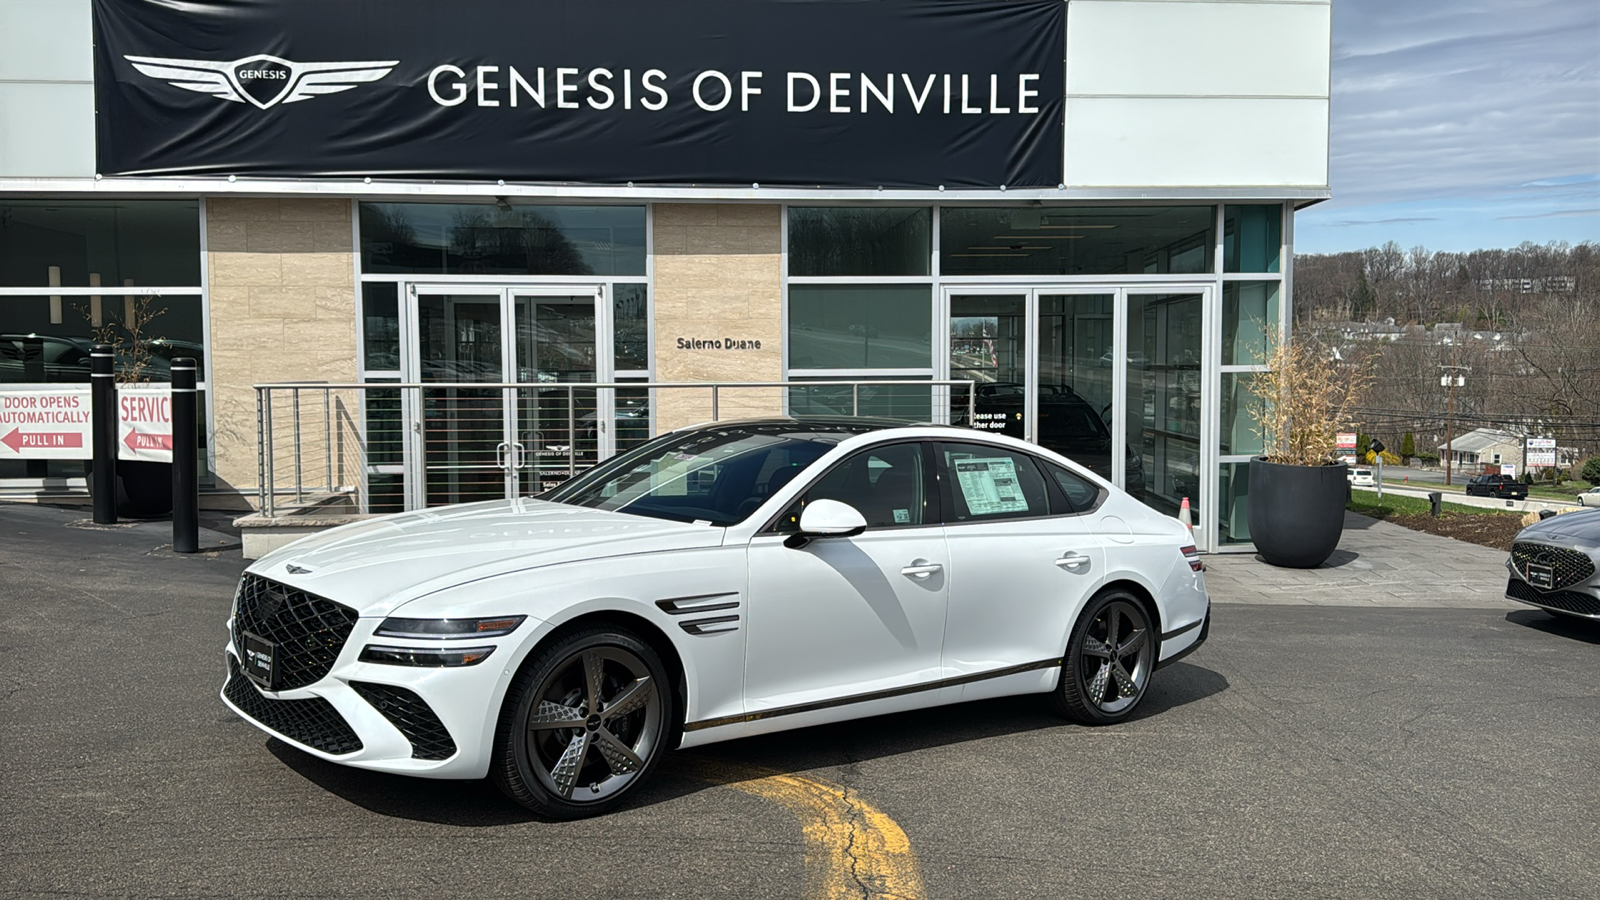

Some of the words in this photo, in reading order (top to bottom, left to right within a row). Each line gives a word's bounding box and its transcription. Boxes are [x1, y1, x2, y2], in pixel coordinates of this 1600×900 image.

[239, 70, 287, 79] GENESIS
[427, 64, 668, 111] GENESIS
[692, 70, 763, 112] OF
[787, 72, 1040, 115] DENVILLE
[677, 337, 722, 350] Salerno
[724, 337, 761, 350] Duane
[4, 396, 37, 409] DOOR
[40, 395, 80, 409] OPENS
[22, 434, 49, 446] PULL
[52, 434, 64, 446] IN
[136, 435, 154, 448] PULL
